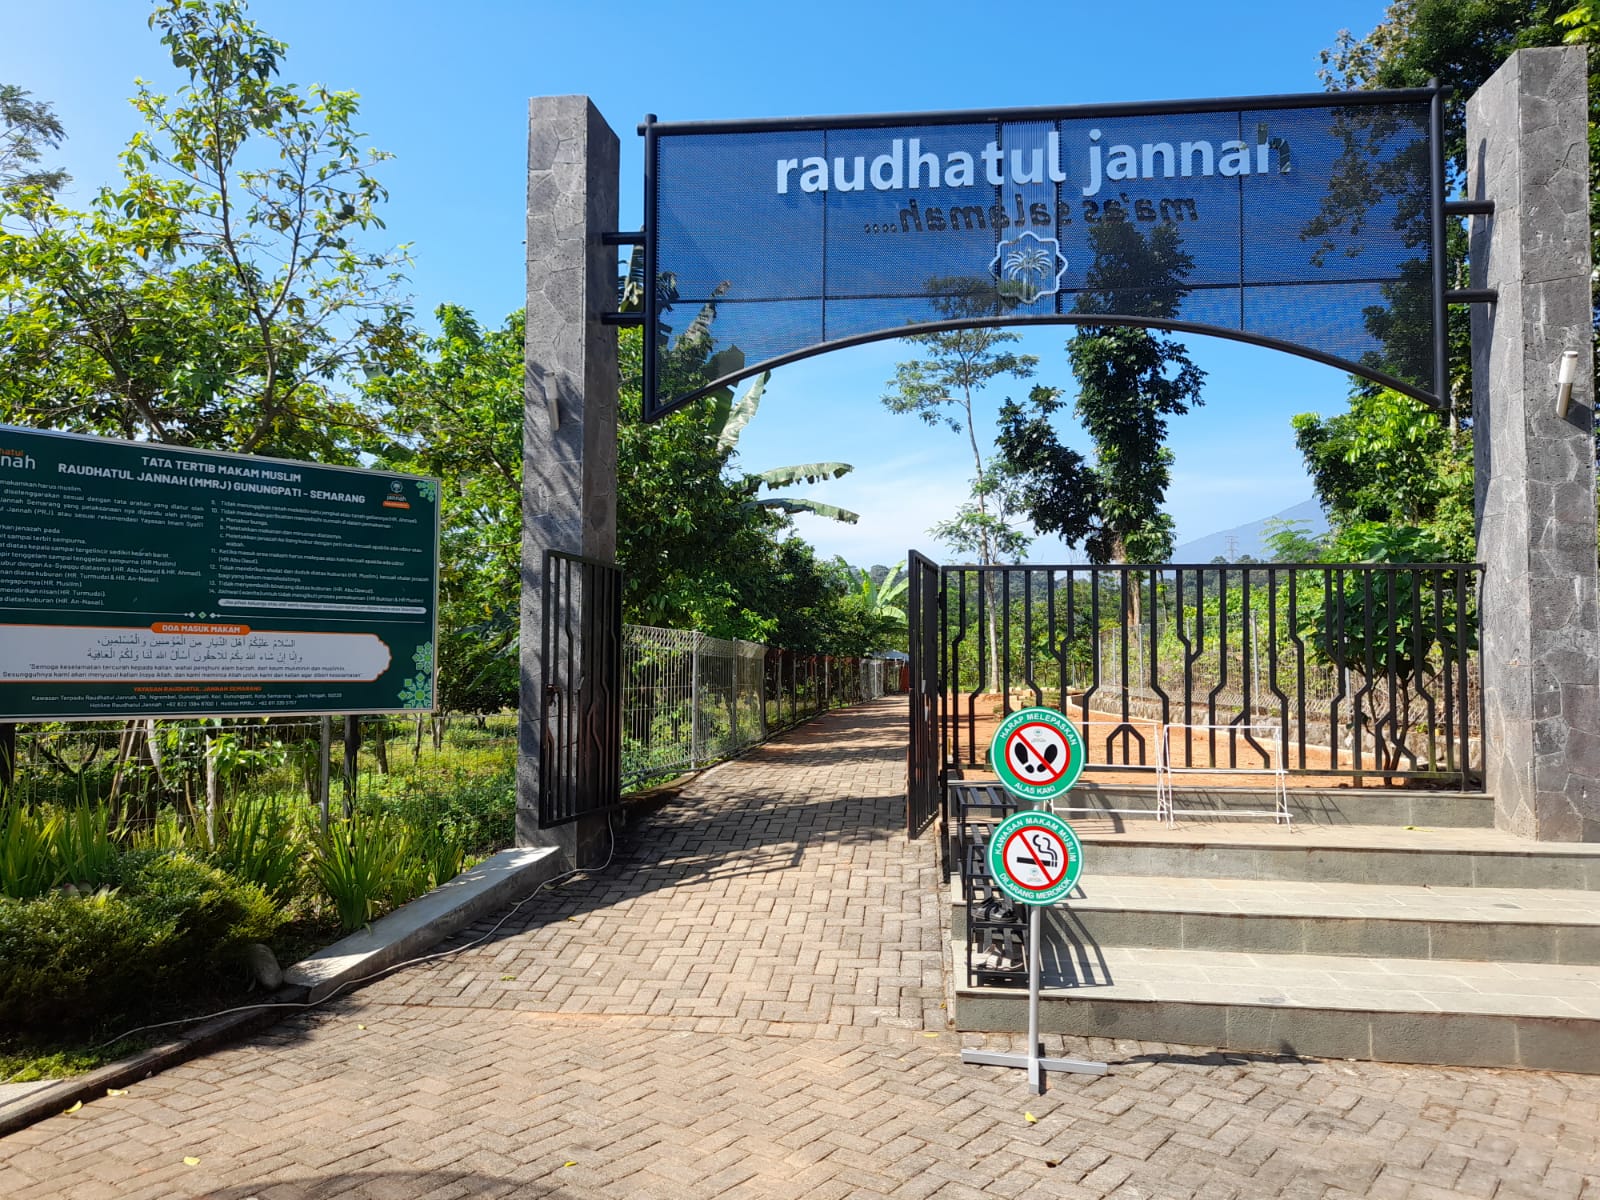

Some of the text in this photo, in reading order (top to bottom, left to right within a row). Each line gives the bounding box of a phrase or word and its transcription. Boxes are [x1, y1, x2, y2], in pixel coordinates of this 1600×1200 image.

[777, 123, 1292, 196] raudhatul jannah
[141, 457, 301, 483] TATA TERTIB MAKAM MUSLIM
[58, 463, 134, 480] RAUDHATUL
[137, 472, 187, 486] JANNAH
[189, 476, 231, 491] (MMRJ)
[233, 482, 301, 497] GUNUNGPATI
[310, 490, 366, 504] SEMARANG
[4, 488, 60, 500] diselenggarakan
[63, 493, 84, 501] sesuai
[87, 495, 111, 504] dengan
[7, 505, 32, 513] Jannah
[27, 498, 60, 508] Semarang
[15, 524, 60, 535] jenazah pada
[7, 532, 31, 541] sampai
[6, 541, 27, 549] diatas
[51, 544, 74, 553] sampai
[12, 550, 47, 560] tenggelam
[48, 553, 73, 561] sampai
[74, 554, 106, 563] tenggelam
[18, 560, 42, 568] dengan
[162, 624, 241, 634] DOA MASUK MAKAM
[1000, 713, 1078, 746] HARAP MELEPASKAN
[1014, 782, 1056, 795] ALAS KAKI
[995, 817, 1077, 862] KAWASAN MAKAM MUSLIM
[1000, 873, 1072, 900] DILARANG MEROKOK
